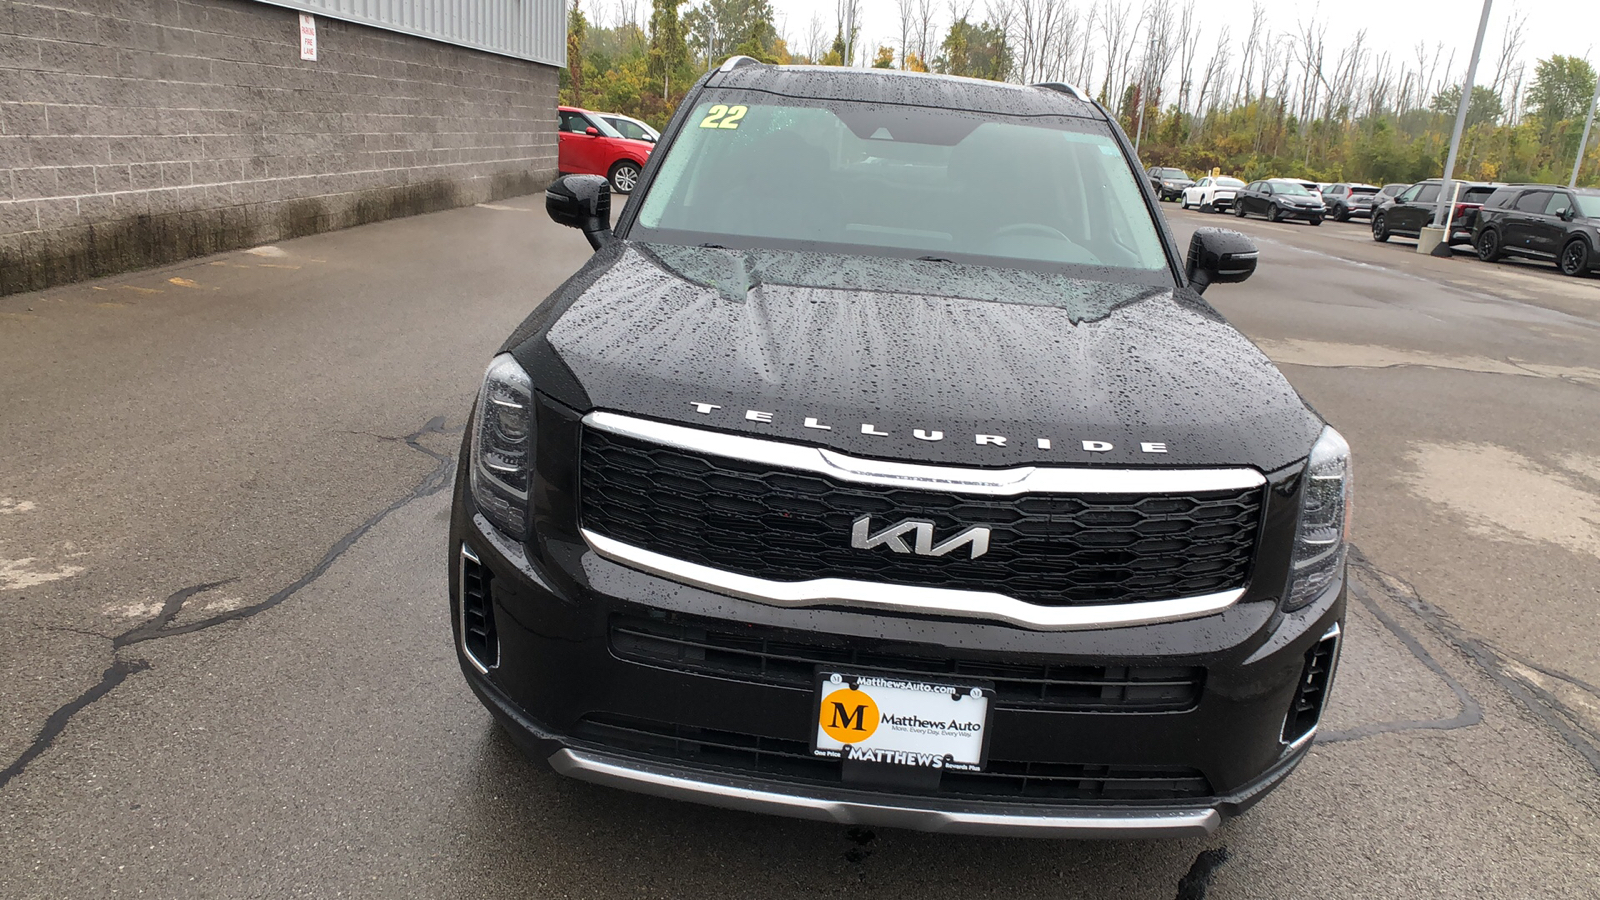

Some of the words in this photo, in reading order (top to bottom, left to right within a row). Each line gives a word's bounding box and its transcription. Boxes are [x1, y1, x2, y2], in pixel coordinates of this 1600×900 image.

[304, 38, 313, 46] FIRE
[699, 104, 748, 130] 22
[690, 401, 1168, 454] TELLURIDE
[851, 516, 990, 560] KIA
[857, 676, 956, 694] MatthewsAuto.com
[827, 701, 869, 732] M
[881, 712, 946, 730] Matthews
[947, 719, 981, 732] Auto
[910, 727, 927, 735] Every
[941, 730, 958, 738] Every
[848, 747, 943, 768] MATTHEWS
